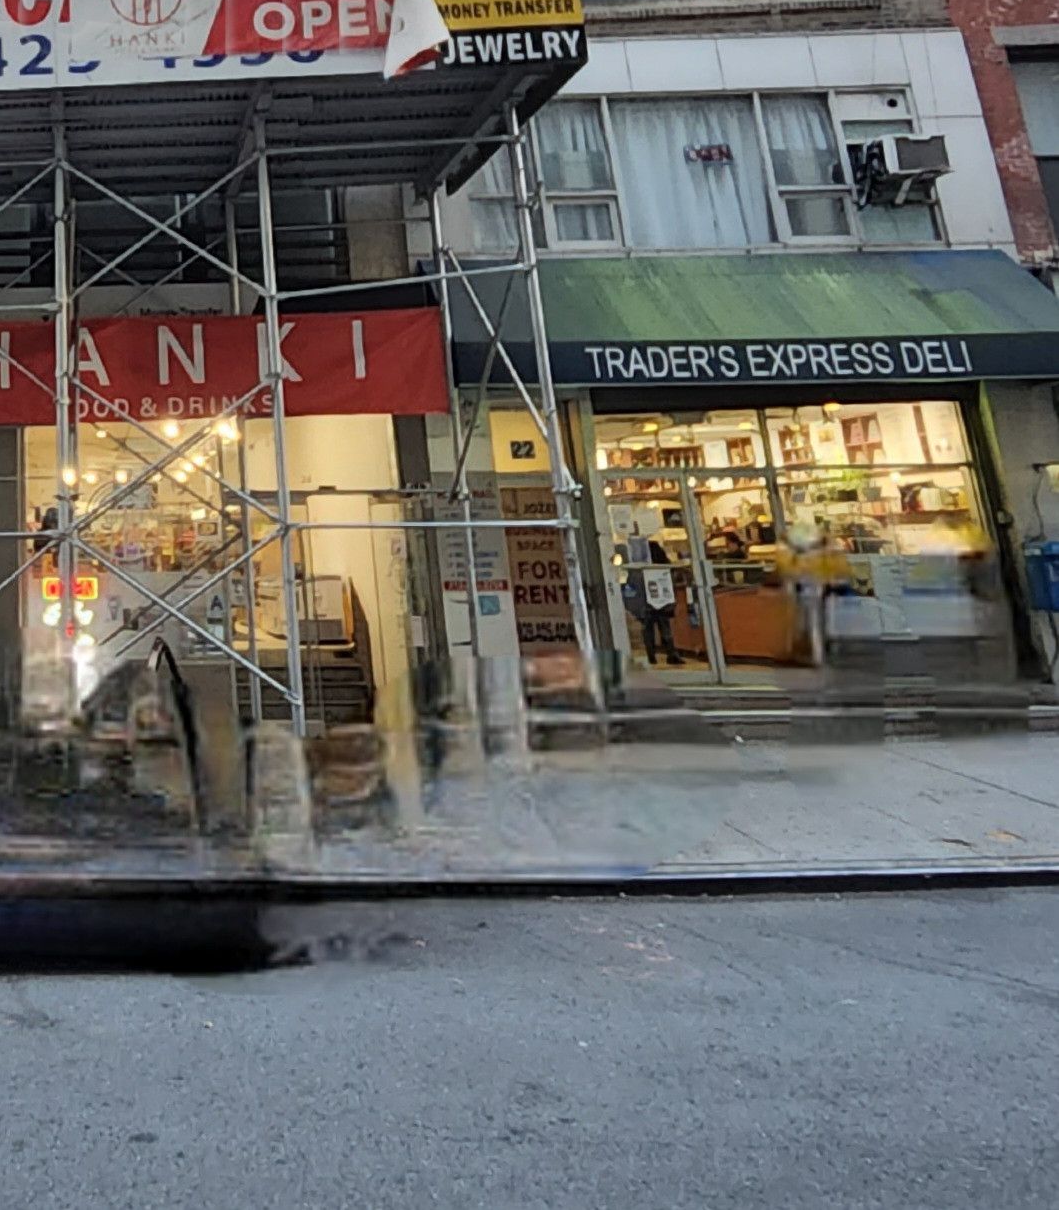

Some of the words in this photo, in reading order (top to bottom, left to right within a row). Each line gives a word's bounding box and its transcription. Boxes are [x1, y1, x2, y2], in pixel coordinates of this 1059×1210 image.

[439, 2, 491, 20] MONEY
[110, 32, 186, 48] HANKI
[443, 30, 581, 65] JEWELRY
[585, 345, 739, 379] TRADER'S
[746, 342, 895, 378] EXPRESS
[901, 340, 973, 373] DELI
[140, 397, 157, 417] &
[510, 441, 535, 459] 22
[518, 561, 561, 580] FOR
[514, 585, 569, 605] RENT
